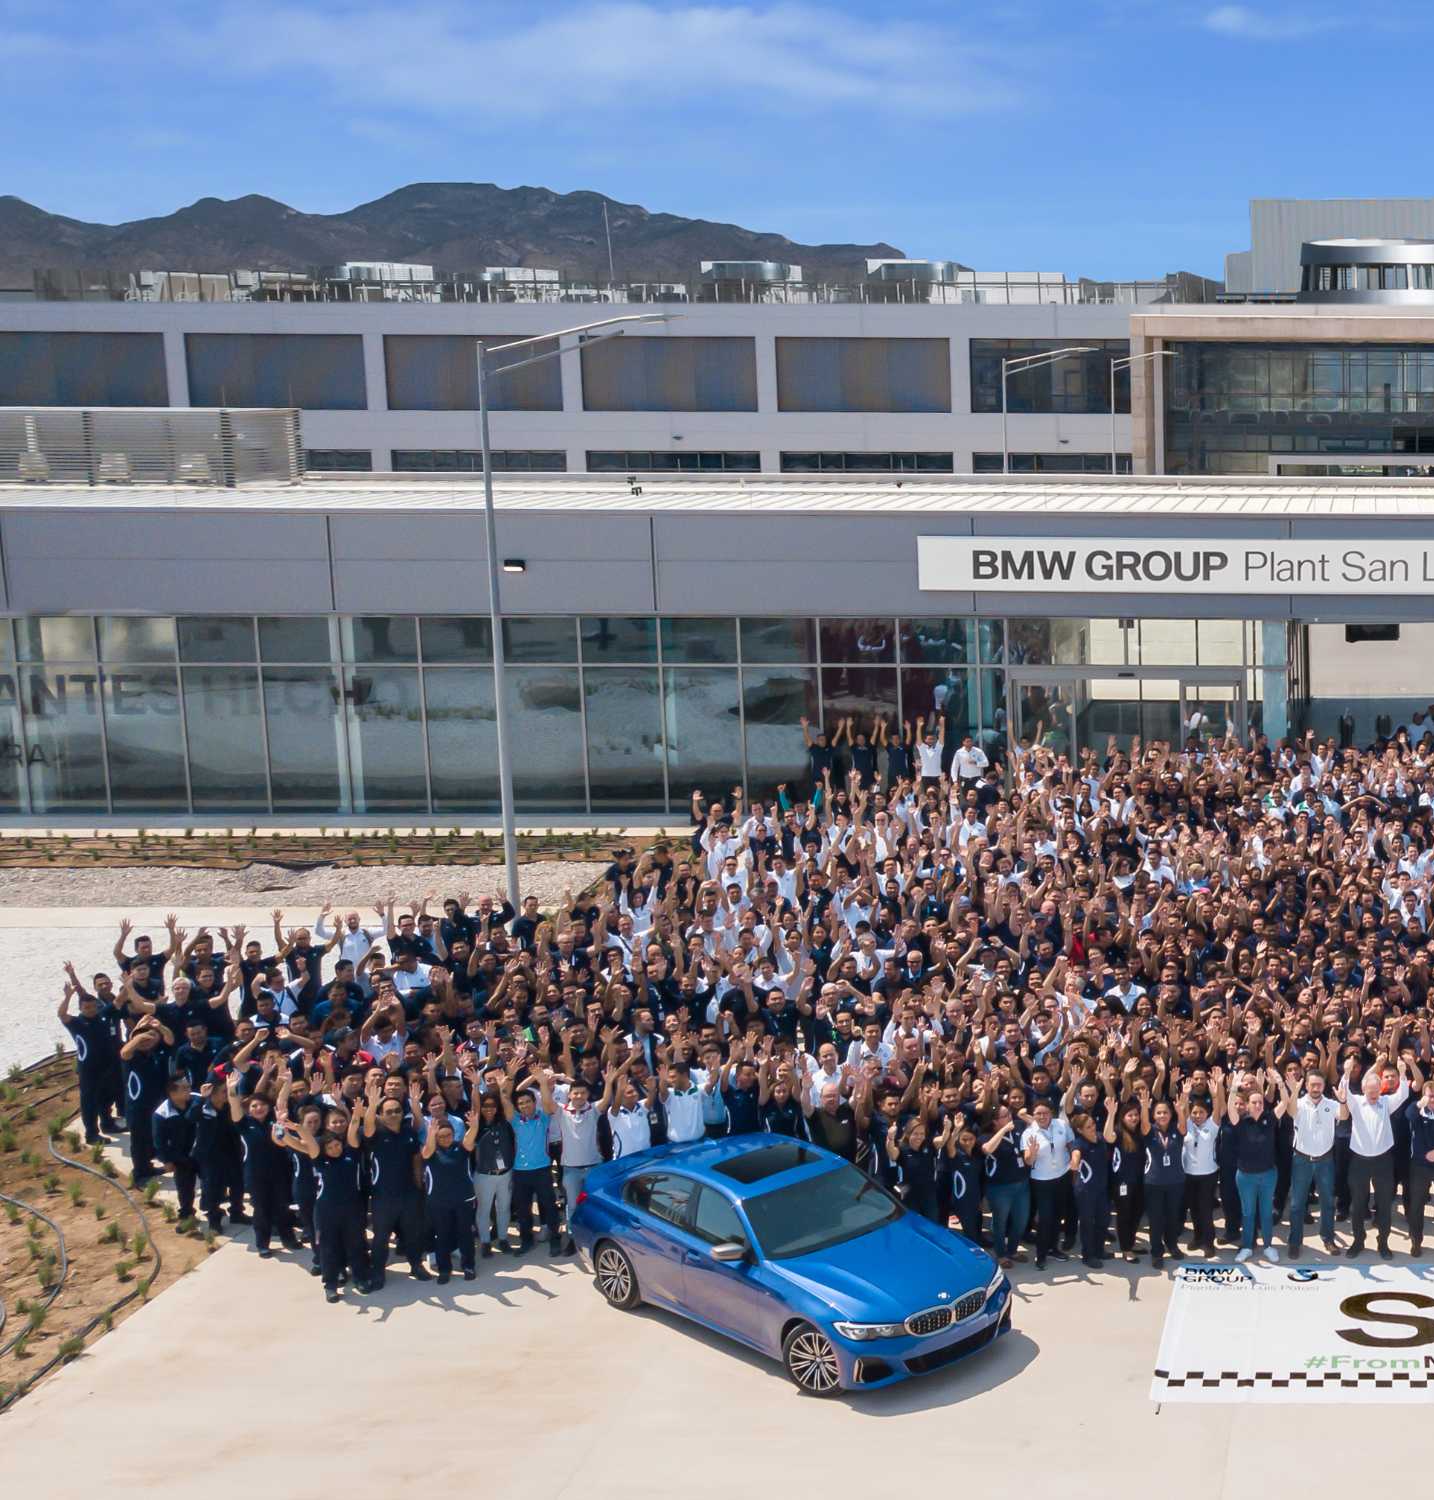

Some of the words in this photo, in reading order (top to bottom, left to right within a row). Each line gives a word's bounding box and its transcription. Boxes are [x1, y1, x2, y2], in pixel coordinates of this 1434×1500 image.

[972, 550, 1076, 581] BMW
[1085, 550, 1229, 582] GROUP
[1244, 550, 1331, 582] Plant
[1341, 550, 1409, 582] San
[1184, 1267, 1235, 1276] BMW
[1182, 1275, 1253, 1283] GROUP
